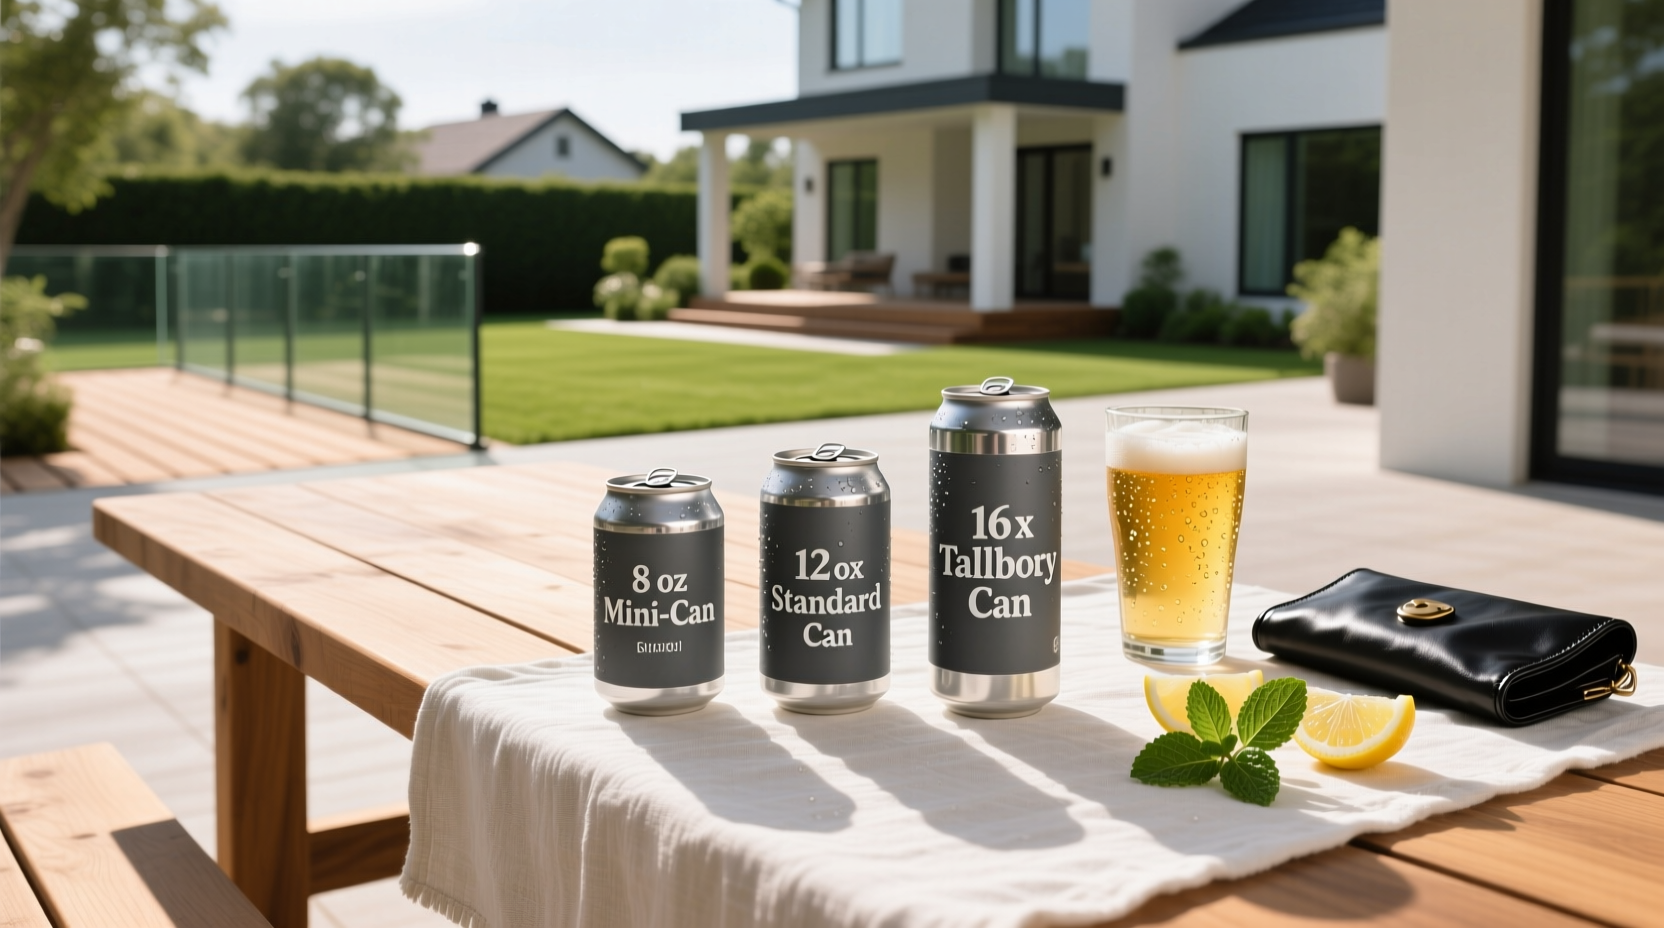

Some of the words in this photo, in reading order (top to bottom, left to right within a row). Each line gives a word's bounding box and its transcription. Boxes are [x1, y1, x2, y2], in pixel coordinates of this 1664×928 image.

[632, 564, 651, 594] 8
[656, 573, 688, 593] oz
[939, 543, 1057, 585] Tallbory
[604, 596, 716, 627] Mini-Can
[771, 582, 882, 615] Standard
[968, 586, 1033, 619] Can
[803, 622, 854, 648] Can
